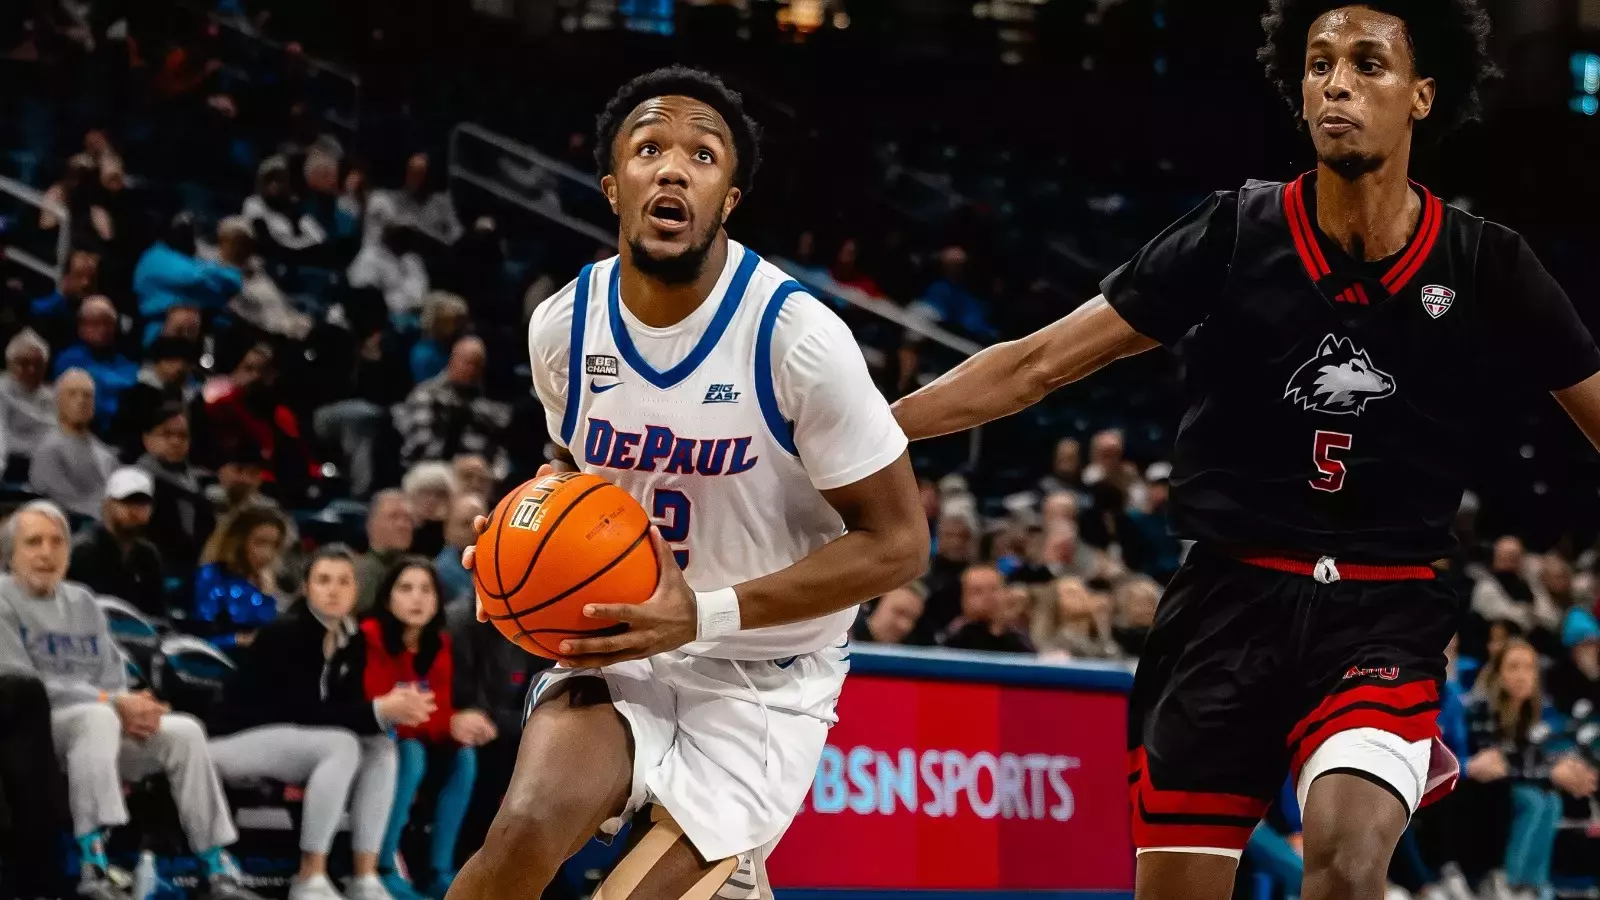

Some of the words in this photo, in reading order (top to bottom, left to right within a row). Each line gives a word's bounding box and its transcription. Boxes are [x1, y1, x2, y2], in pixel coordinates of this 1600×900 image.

[1422, 294, 1451, 306] MAC
[704, 392, 742, 401] EAST
[708, 384, 735, 392] BIG
[1308, 430, 1353, 493] 5
[653, 489, 691, 572] 2
[812, 744, 918, 815] BSN
[919, 749, 1081, 822] SPORTS
